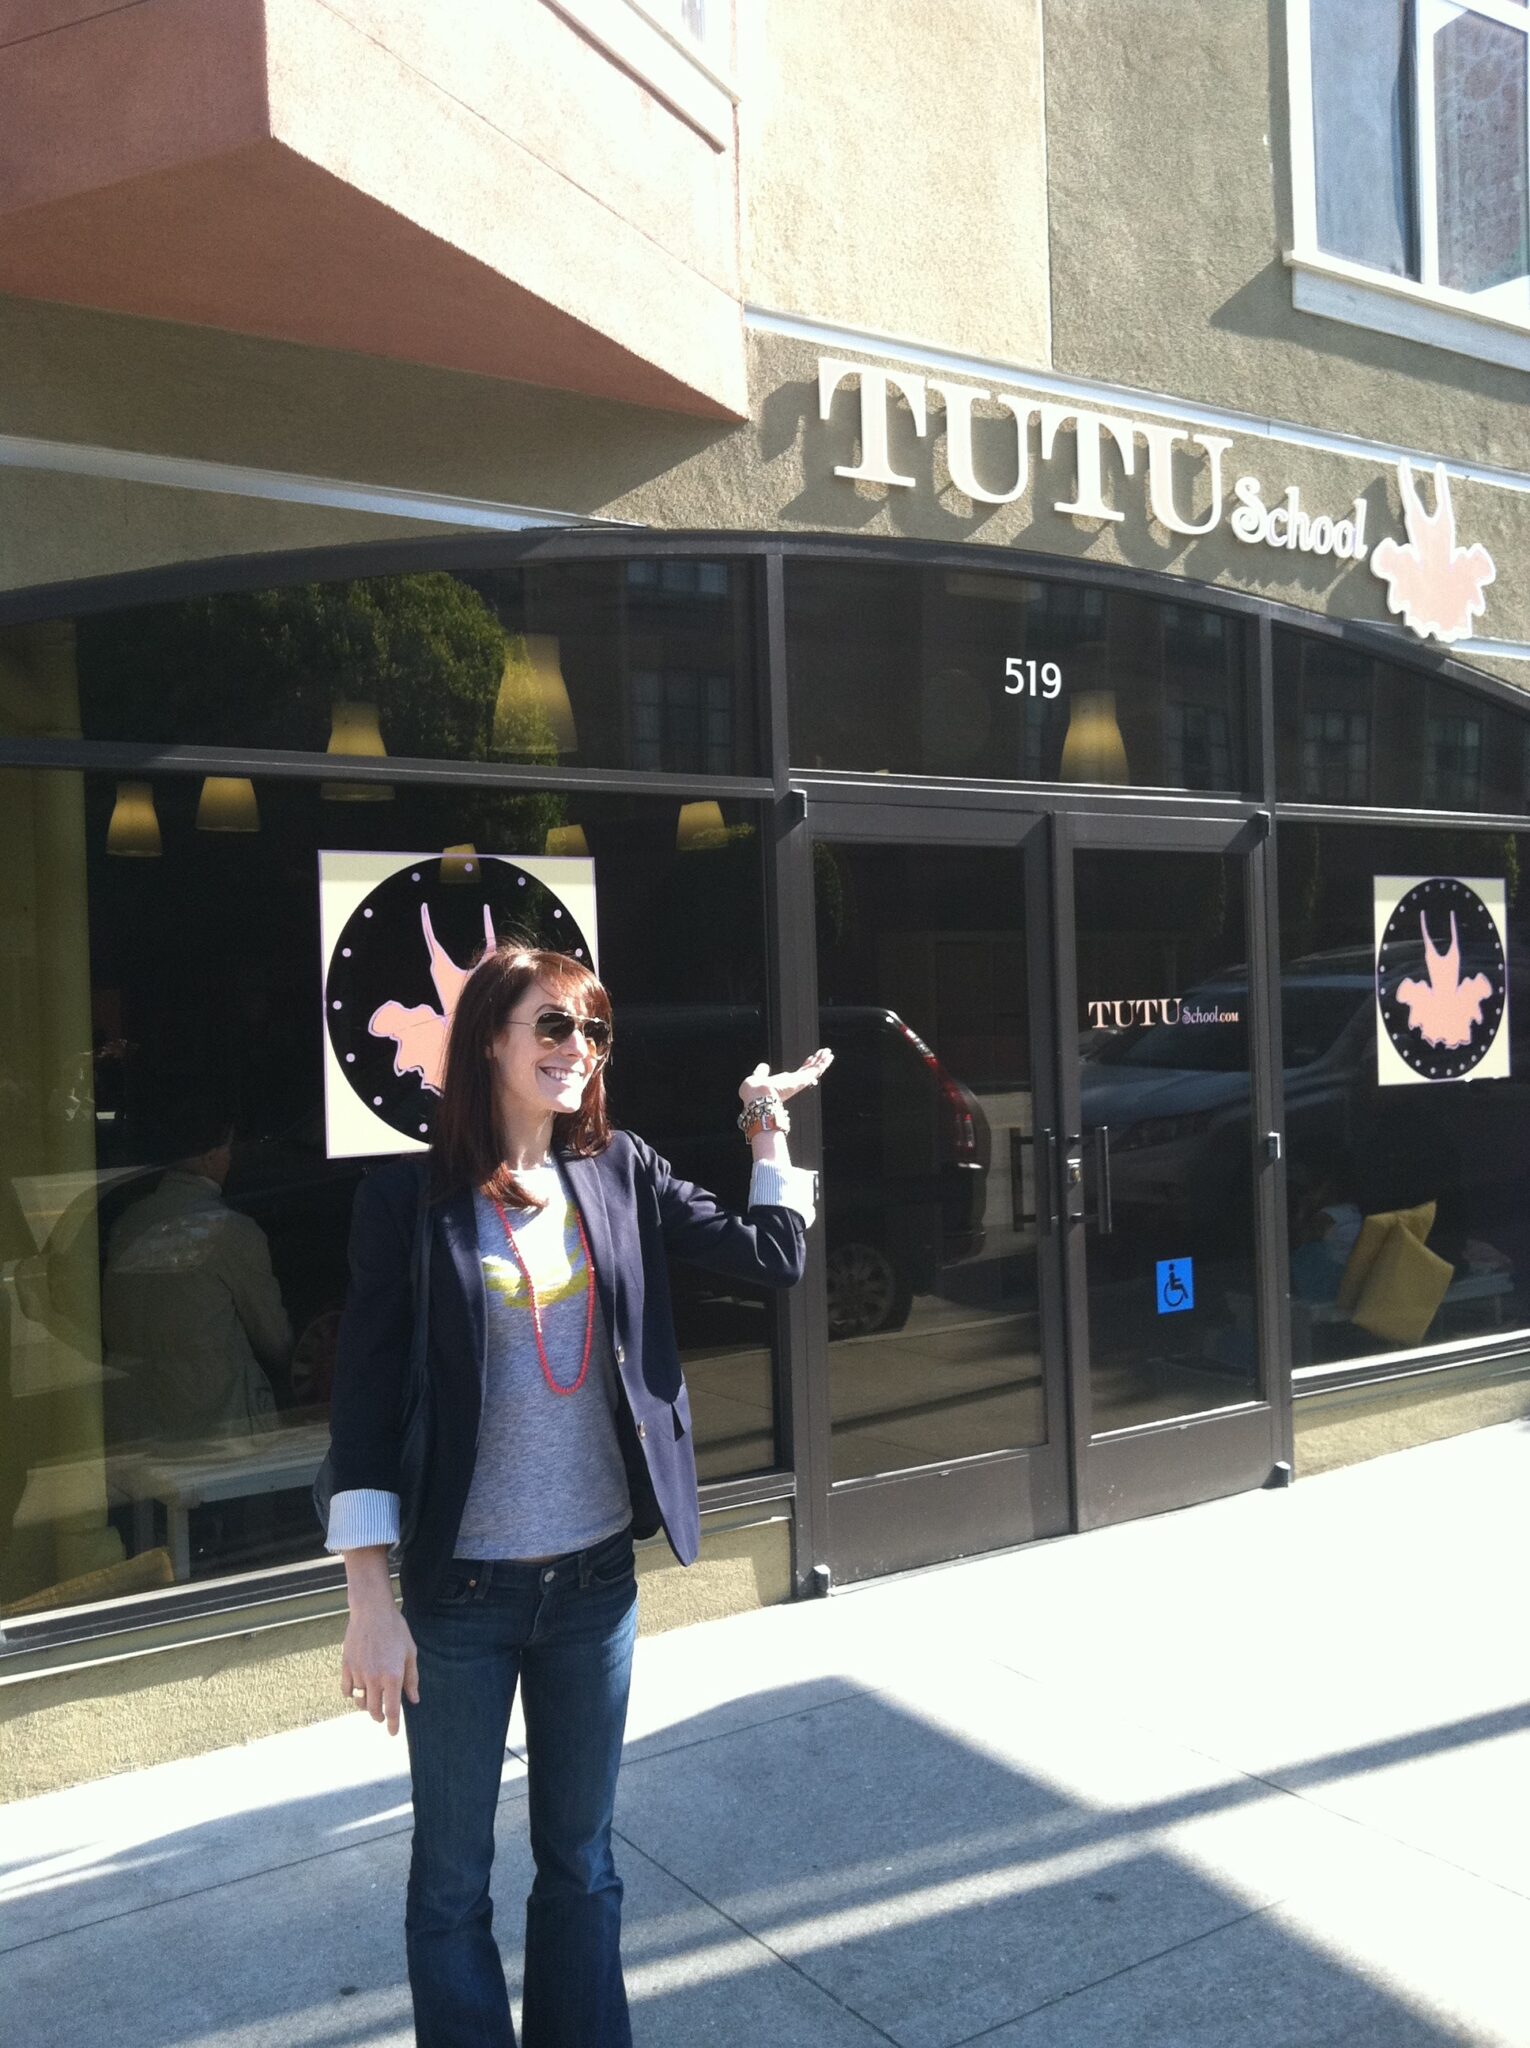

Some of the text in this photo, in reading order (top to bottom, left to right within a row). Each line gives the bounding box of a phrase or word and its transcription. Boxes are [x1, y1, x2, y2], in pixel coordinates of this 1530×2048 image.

[818, 357, 1368, 559] TUTU School
[1004, 657, 1062, 699] 519
[1088, 998, 1182, 1028] TUTU
